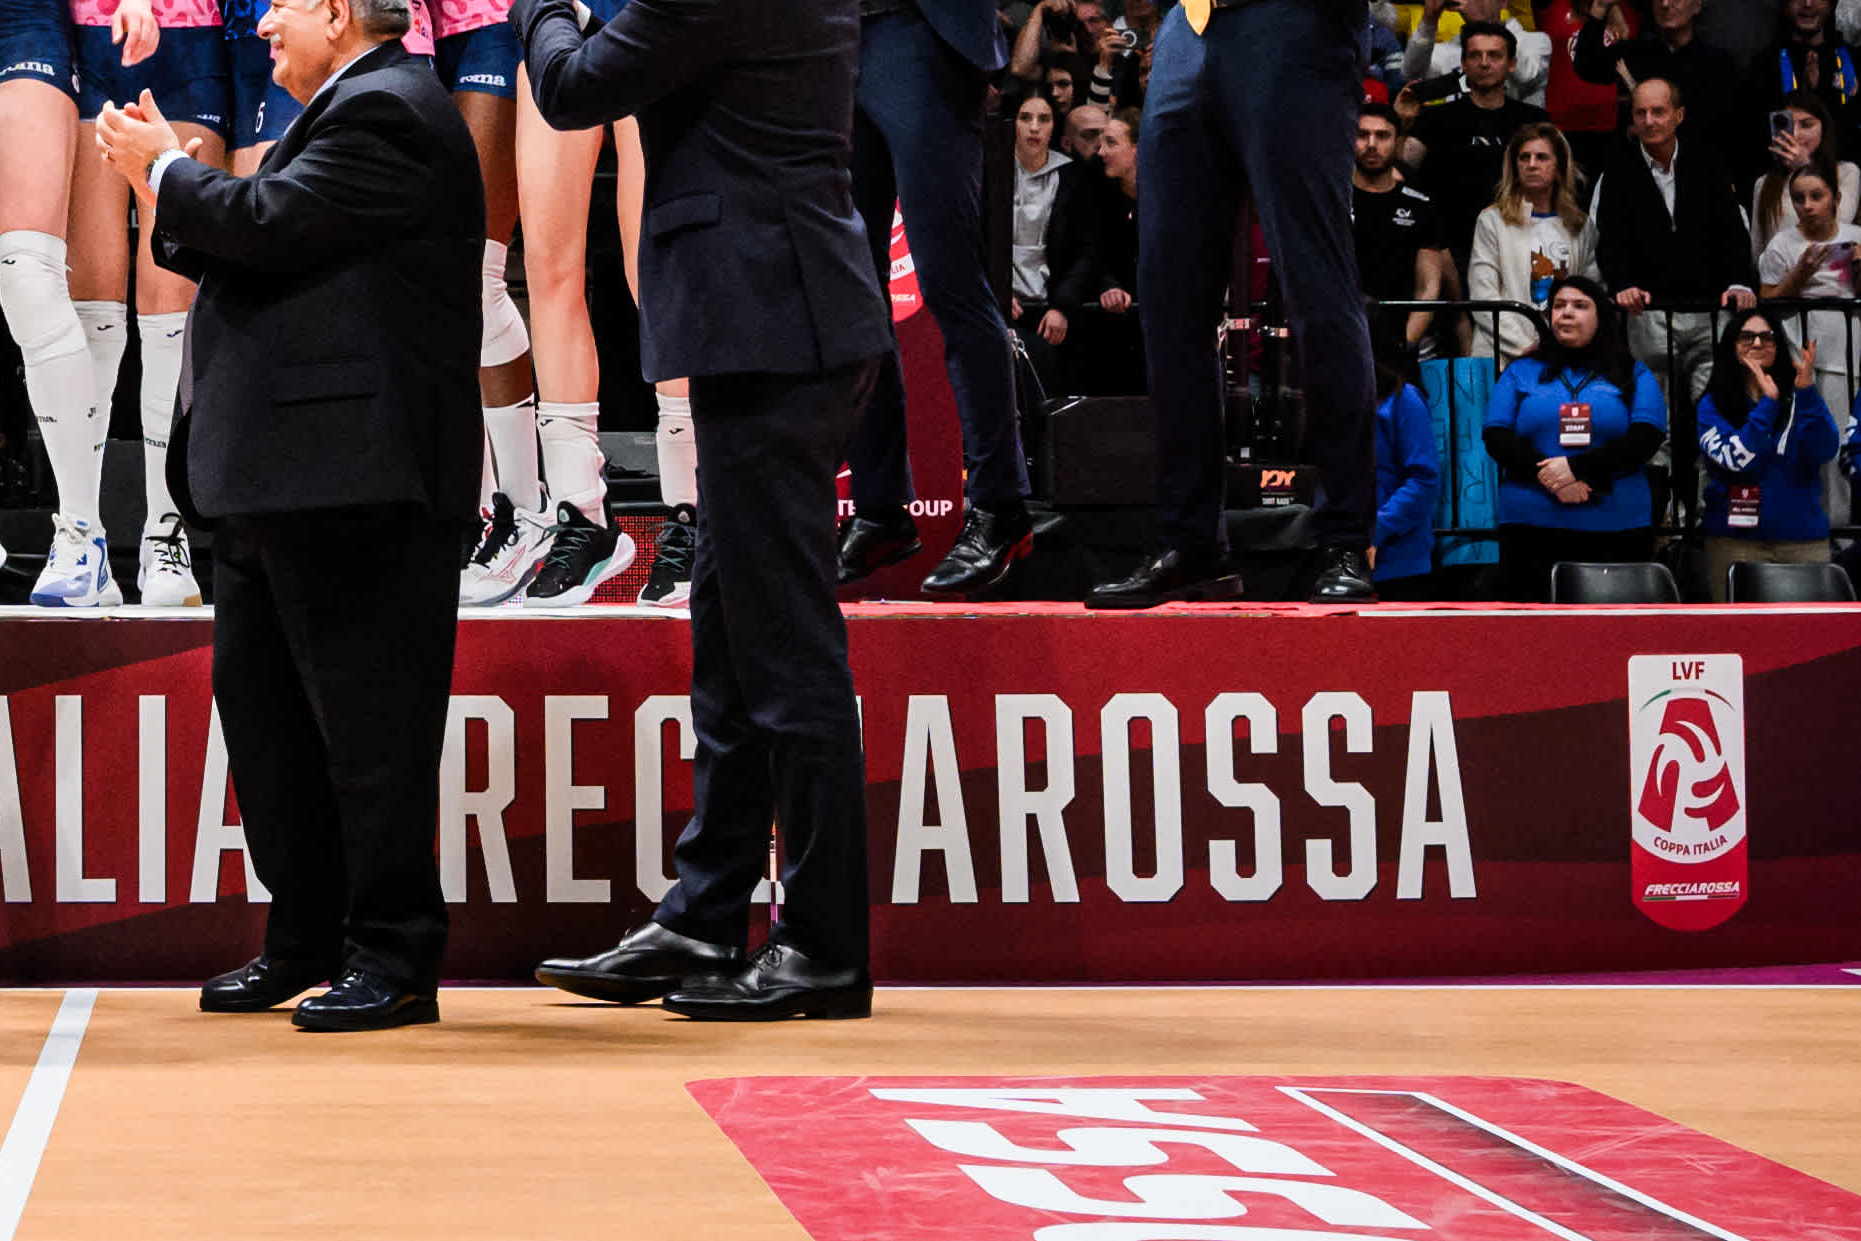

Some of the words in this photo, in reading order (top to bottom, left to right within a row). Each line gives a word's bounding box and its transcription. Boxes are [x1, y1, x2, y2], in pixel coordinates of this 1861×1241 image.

[909, 499, 954, 517] OUP
[1671, 660, 1706, 681] LVF
[439, 692, 1477, 904] RECAROSSA
[1653, 835, 1690, 856] COPPA
[1693, 833, 1728, 856] ITALIA
[1644, 879, 1741, 896] FRECCIAROSSA
